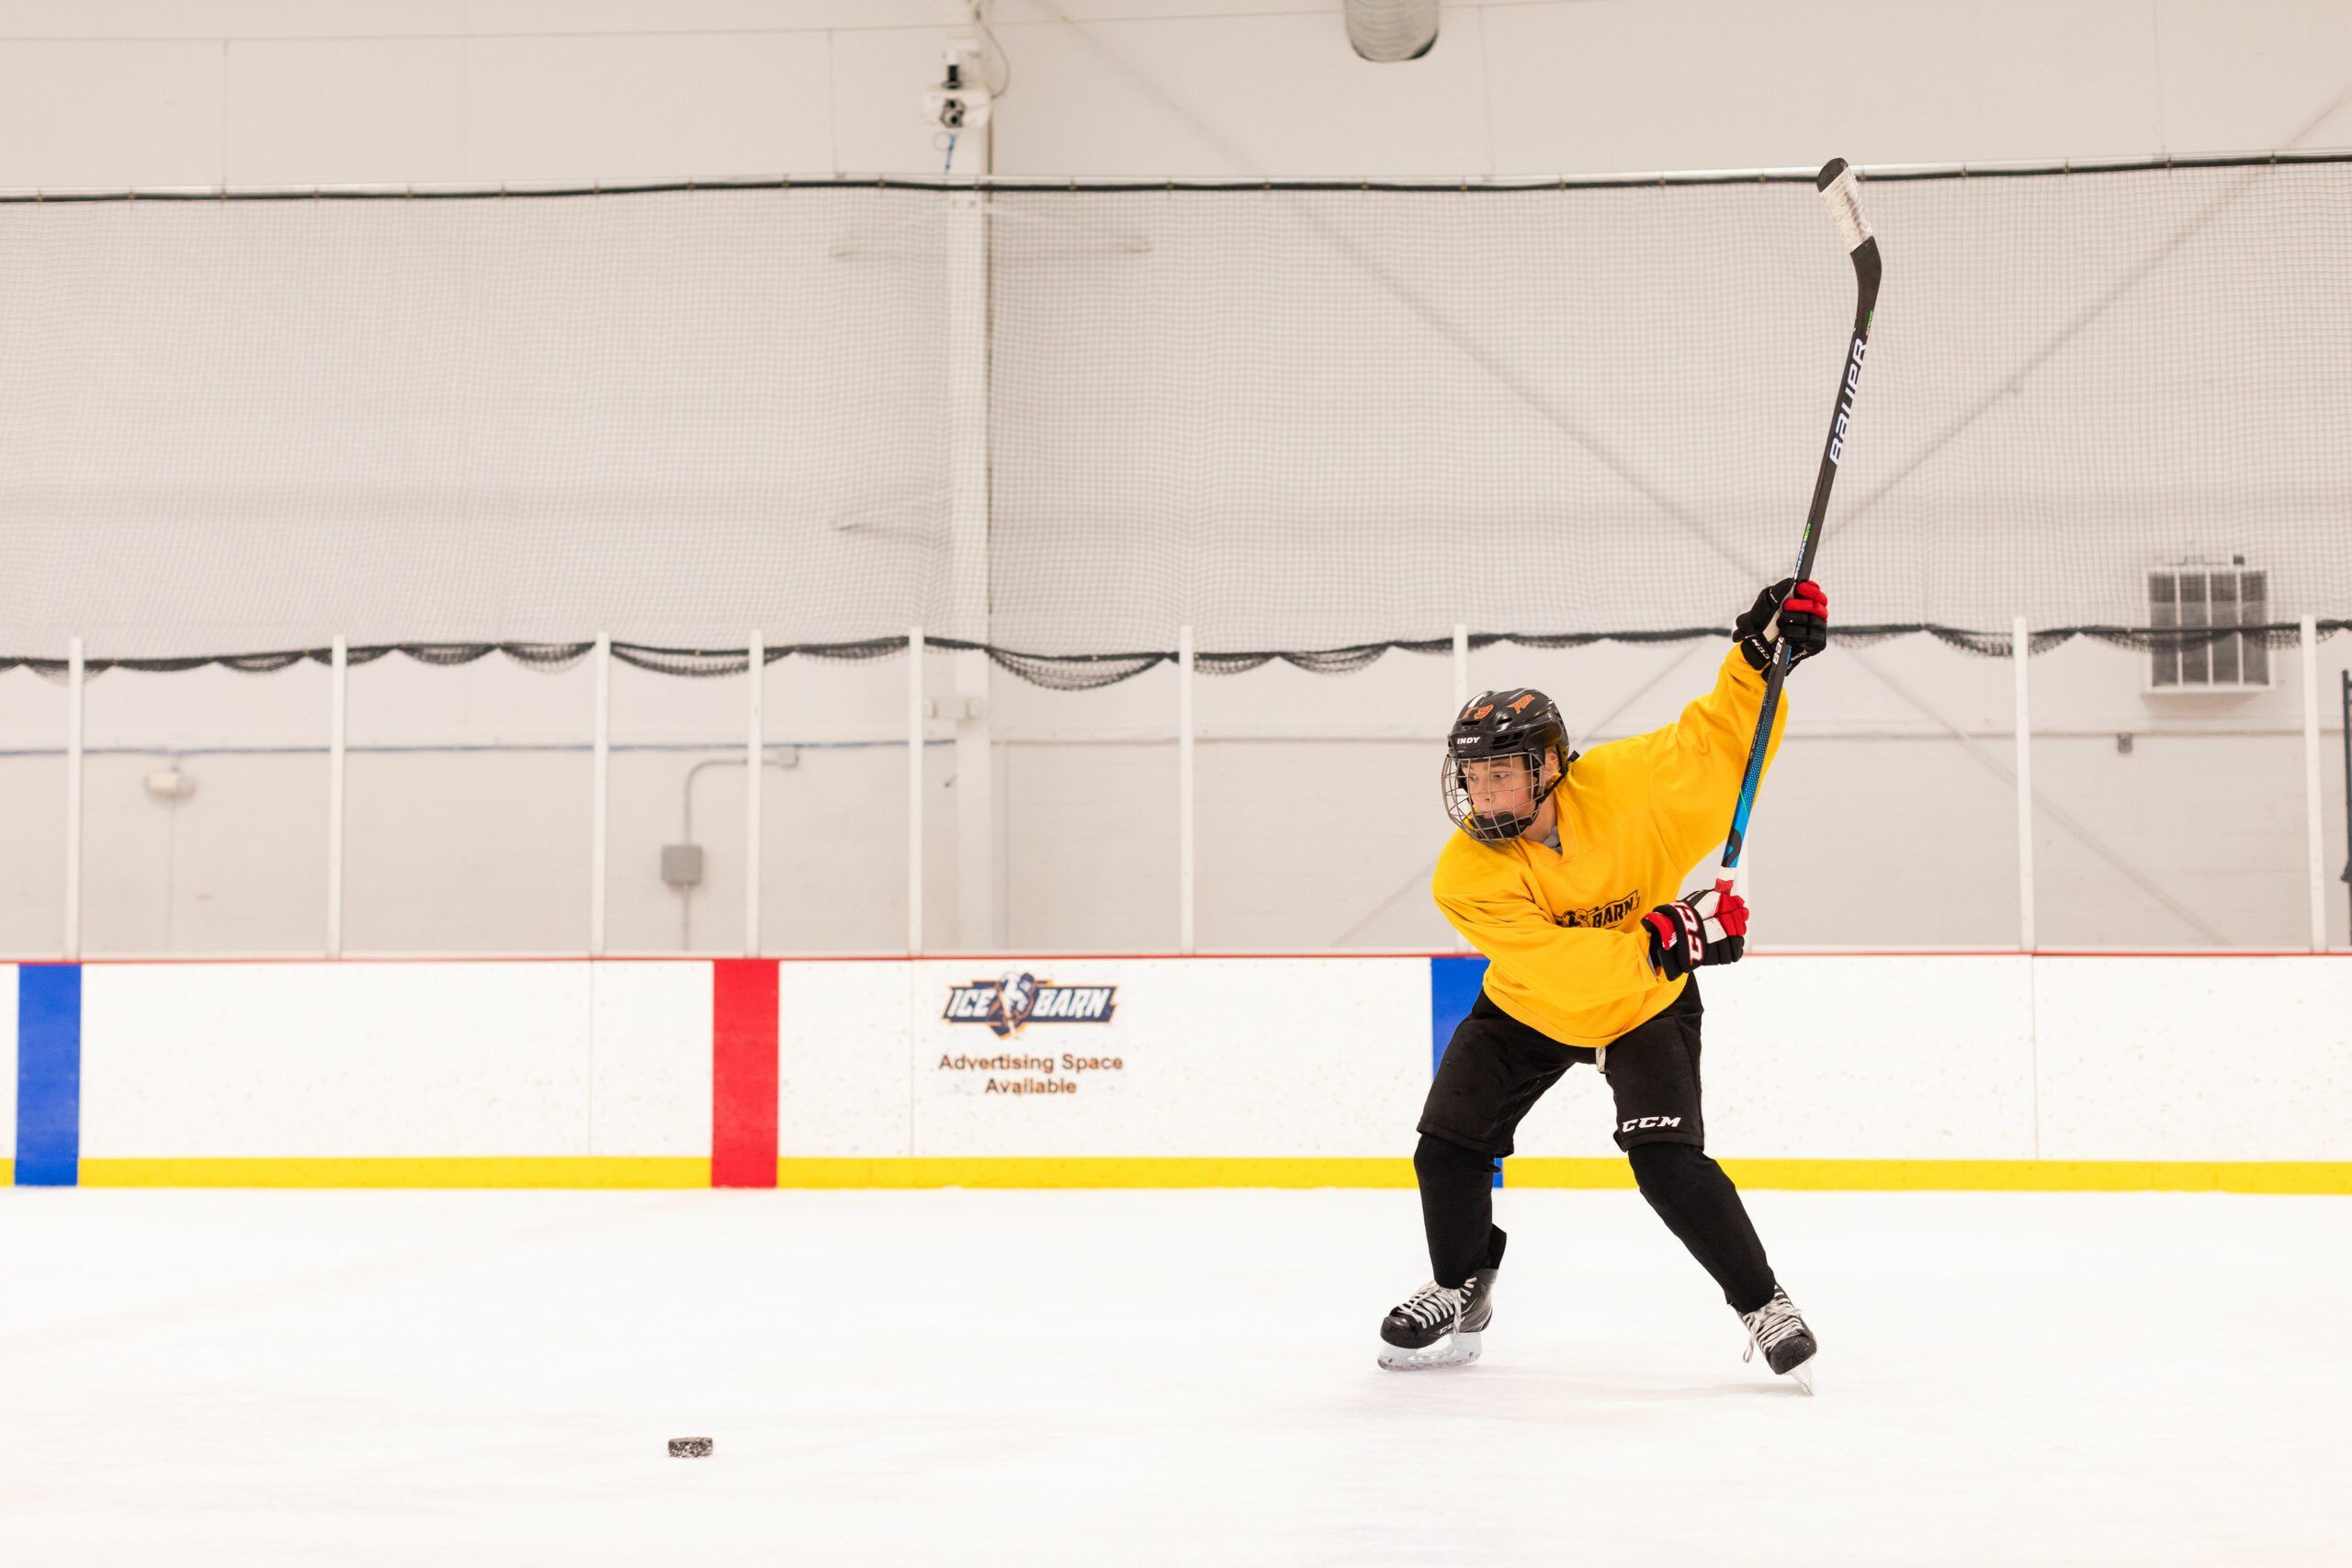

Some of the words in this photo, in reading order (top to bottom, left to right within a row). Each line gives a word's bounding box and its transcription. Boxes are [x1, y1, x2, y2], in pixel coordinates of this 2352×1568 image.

[1457, 737, 1480, 745] INDY
[1592, 897, 1634, 928] BARN
[947, 988, 997, 1017] ICE
[1032, 988, 1110, 1019] BARN
[939, 1055, 1054, 1074] Advertising
[1062, 1054, 1124, 1073] Space
[986, 1078, 1077, 1094] Available
[1622, 1116, 1681, 1133] CCM
